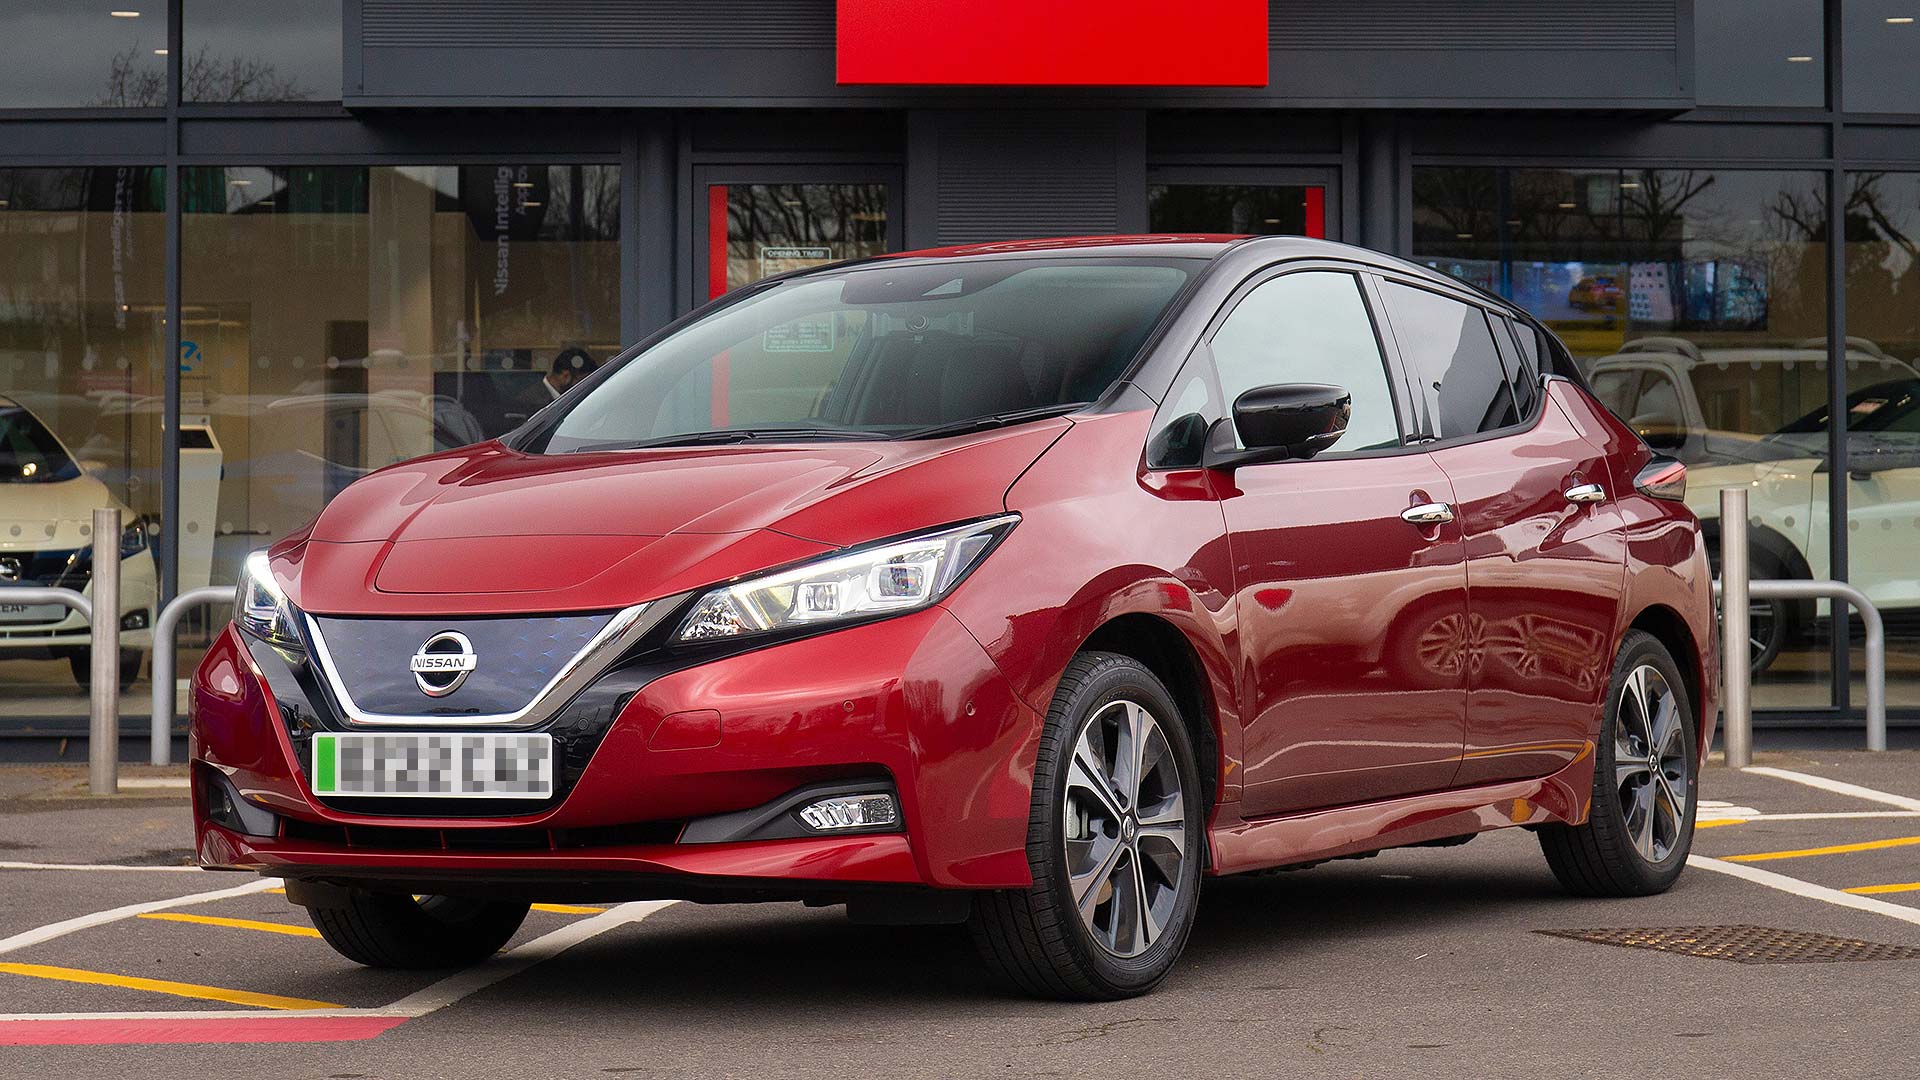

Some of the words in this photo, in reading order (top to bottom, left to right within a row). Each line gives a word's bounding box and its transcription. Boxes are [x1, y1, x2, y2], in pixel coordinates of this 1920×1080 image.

[494, 166, 513, 229] Intellig
[494, 235, 509, 296] Nissan
[0, 604, 29, 613] EAF
[413, 657, 466, 668] NISSAN
